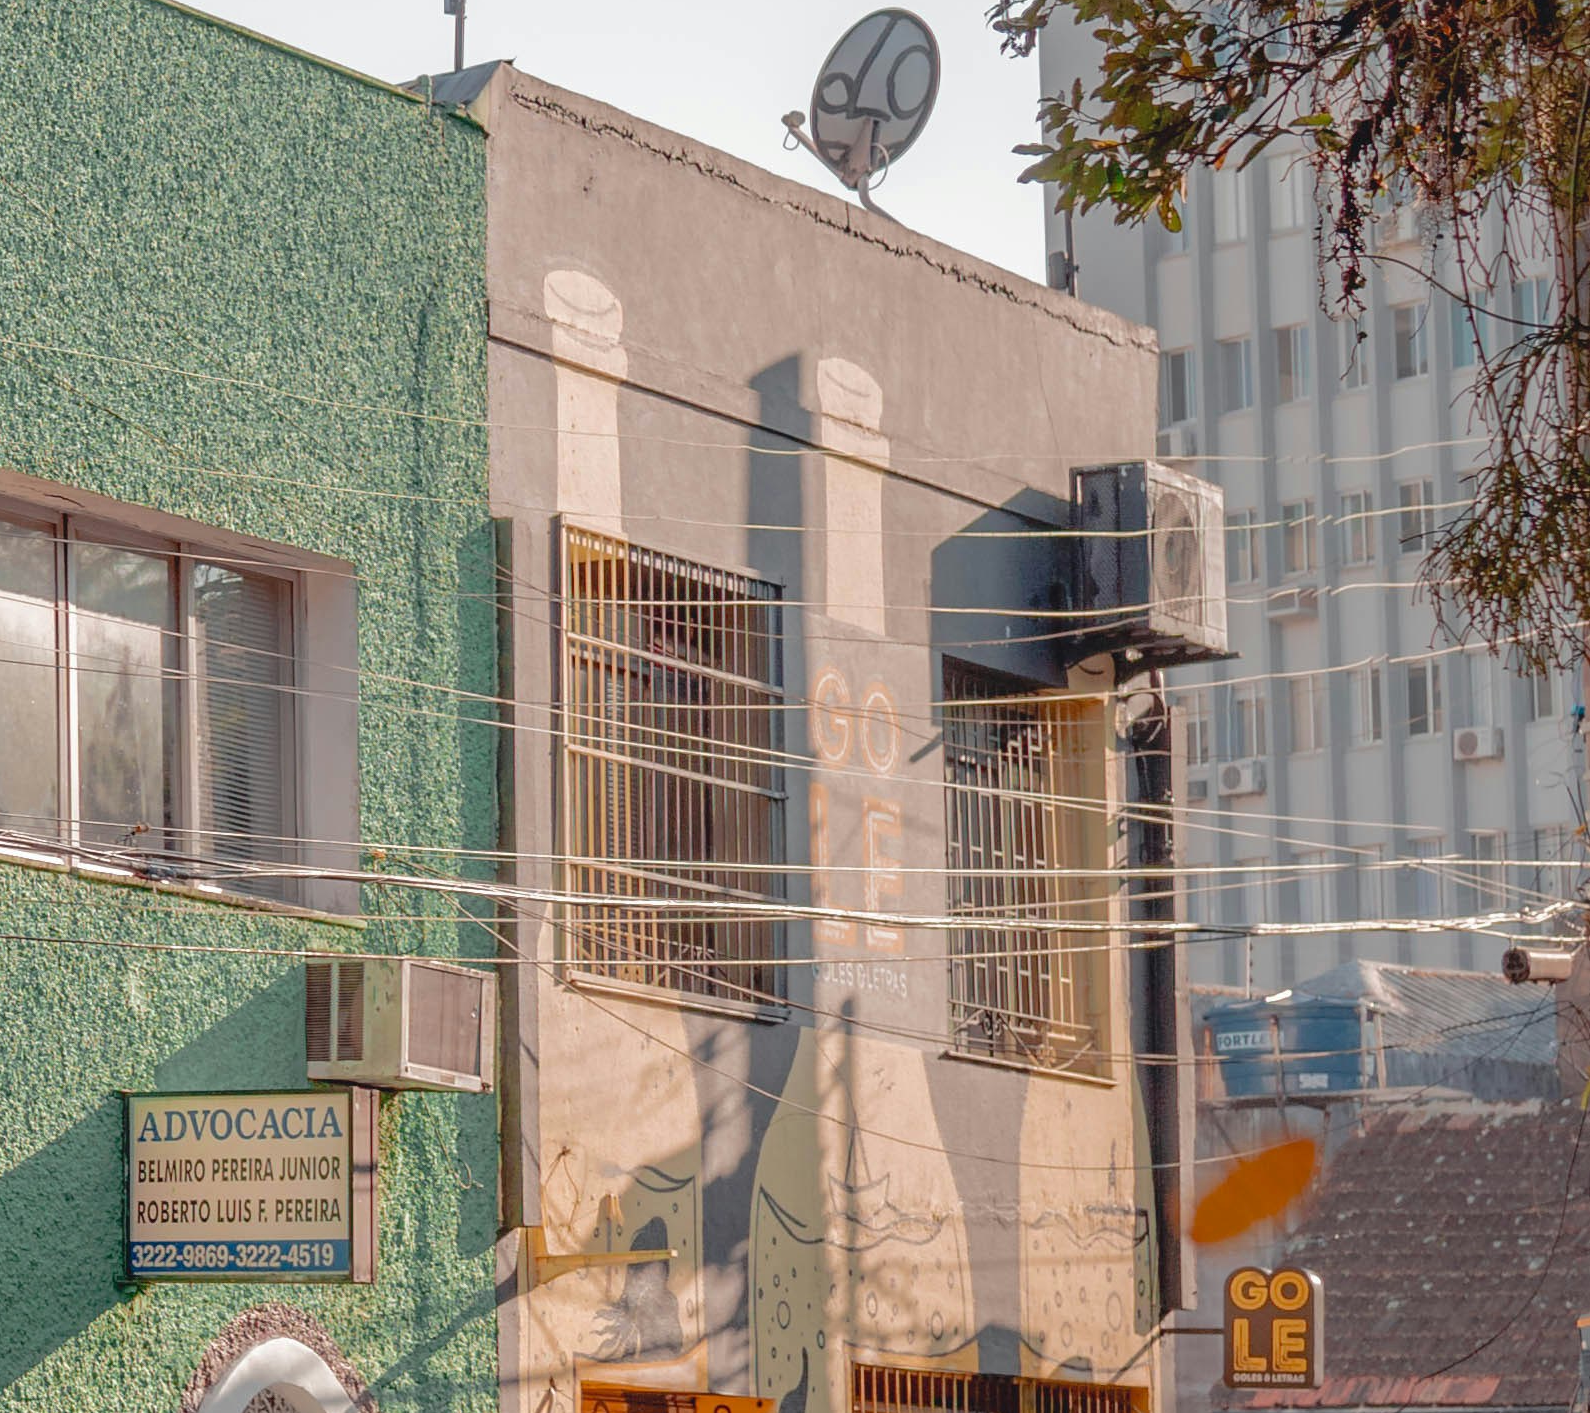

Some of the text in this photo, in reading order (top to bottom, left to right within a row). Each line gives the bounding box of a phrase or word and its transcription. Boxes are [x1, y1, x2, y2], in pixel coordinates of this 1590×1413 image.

[810, 665, 901, 777] GO
[137, 1106, 343, 1143] ADVOCACIA
[138, 1155, 342, 1184] BELMIRO PEREIRA JUNIOR
[137, 1197, 342, 1224] ROBERTO LUIS F. PEREIRA
[1230, 1270, 1310, 1312] GO
[1233, 1317, 1308, 1373] LE
[1233, 1372, 1262, 1384] GOLES
